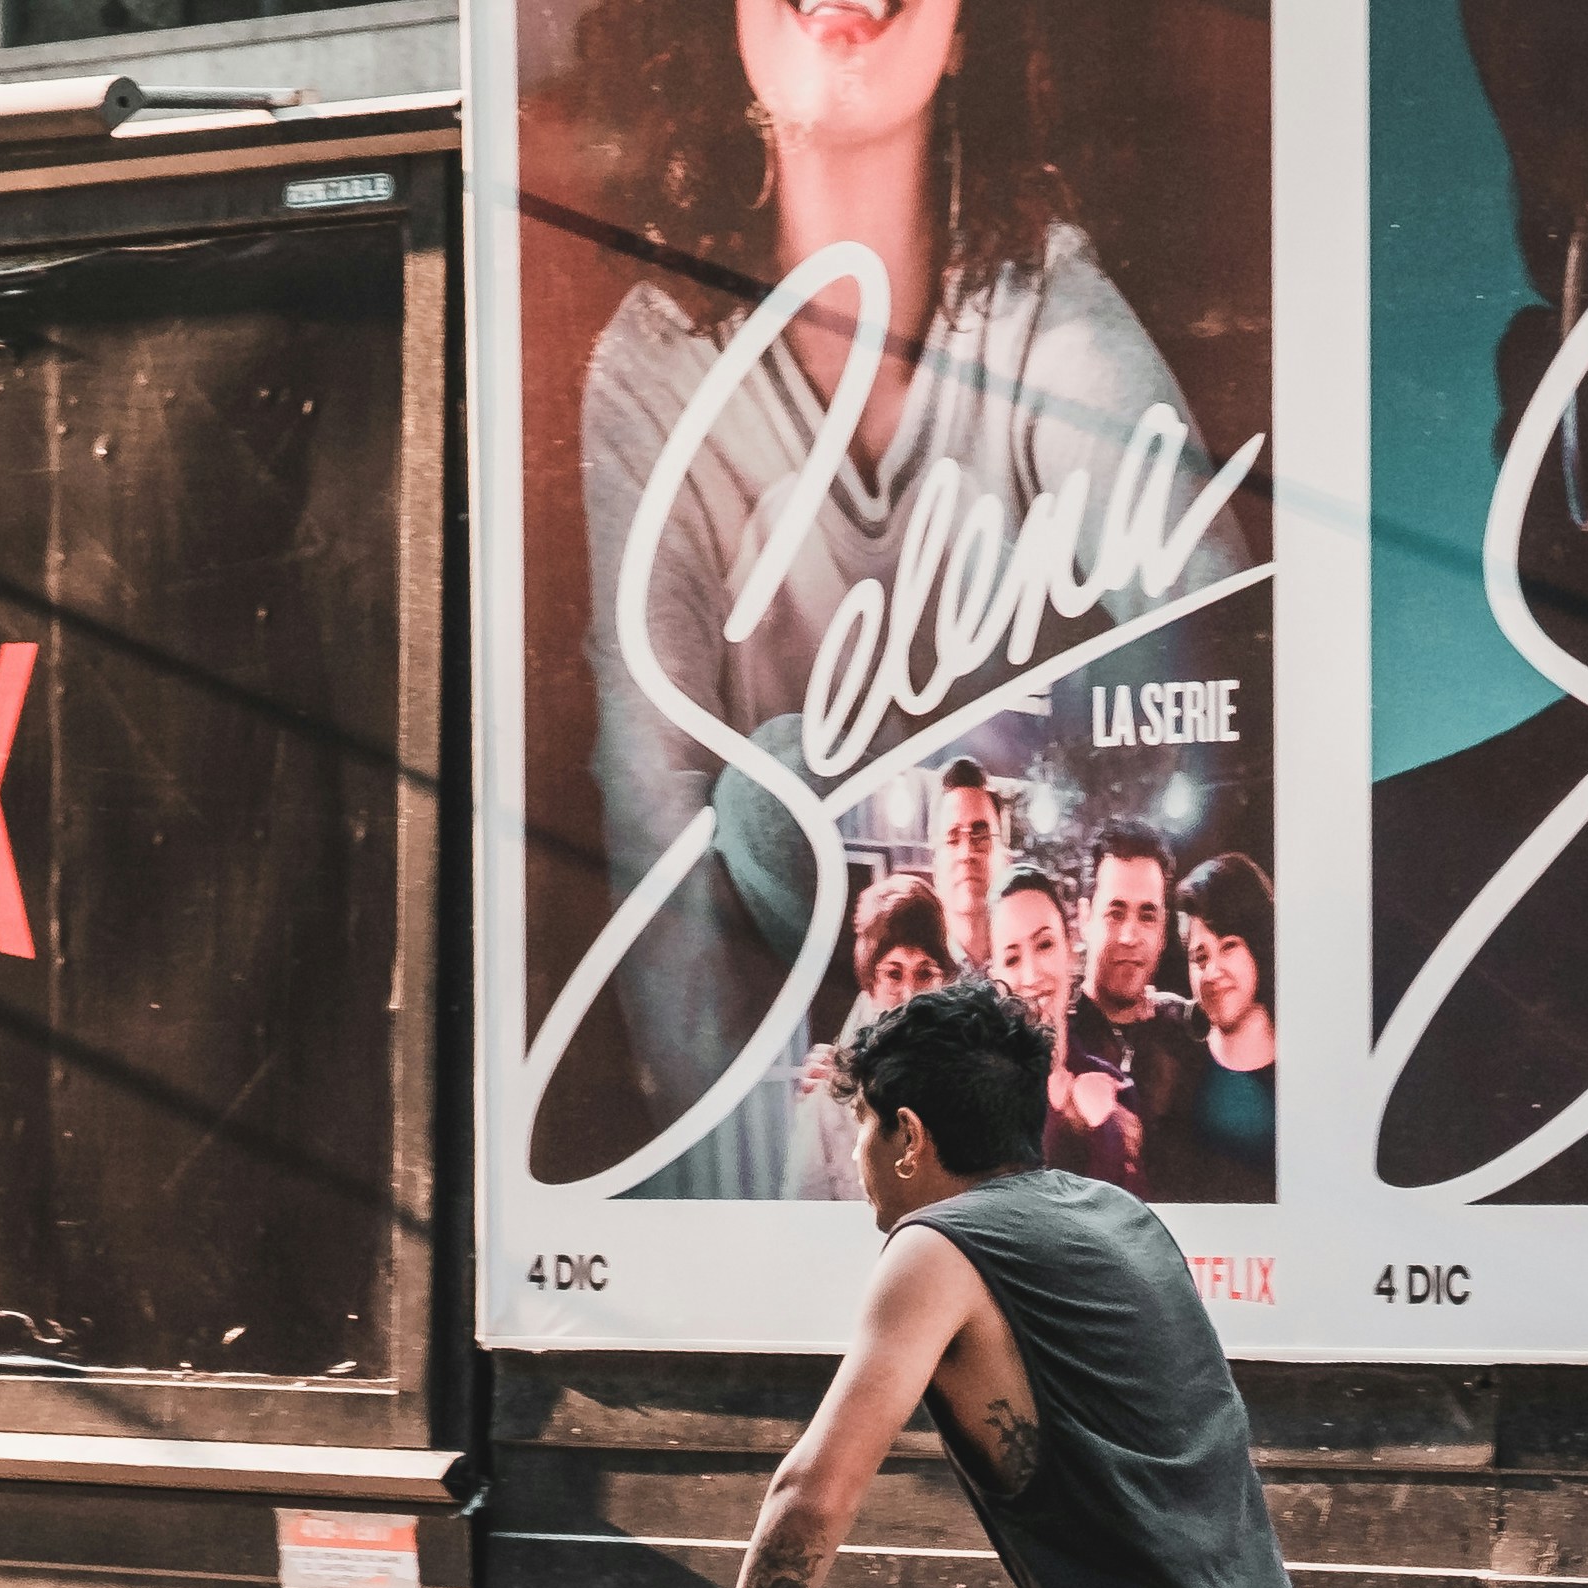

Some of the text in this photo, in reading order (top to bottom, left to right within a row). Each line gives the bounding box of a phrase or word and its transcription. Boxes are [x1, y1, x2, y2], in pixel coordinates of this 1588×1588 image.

[525, 241, 1277, 1200] Selena
[1092, 679, 1240, 747] LA SERIE
[527, 1254, 609, 1291] 4 DIC
[1184, 1257, 1276, 1305] TFLIX
[1374, 1264, 1471, 1306] 4 DIC
